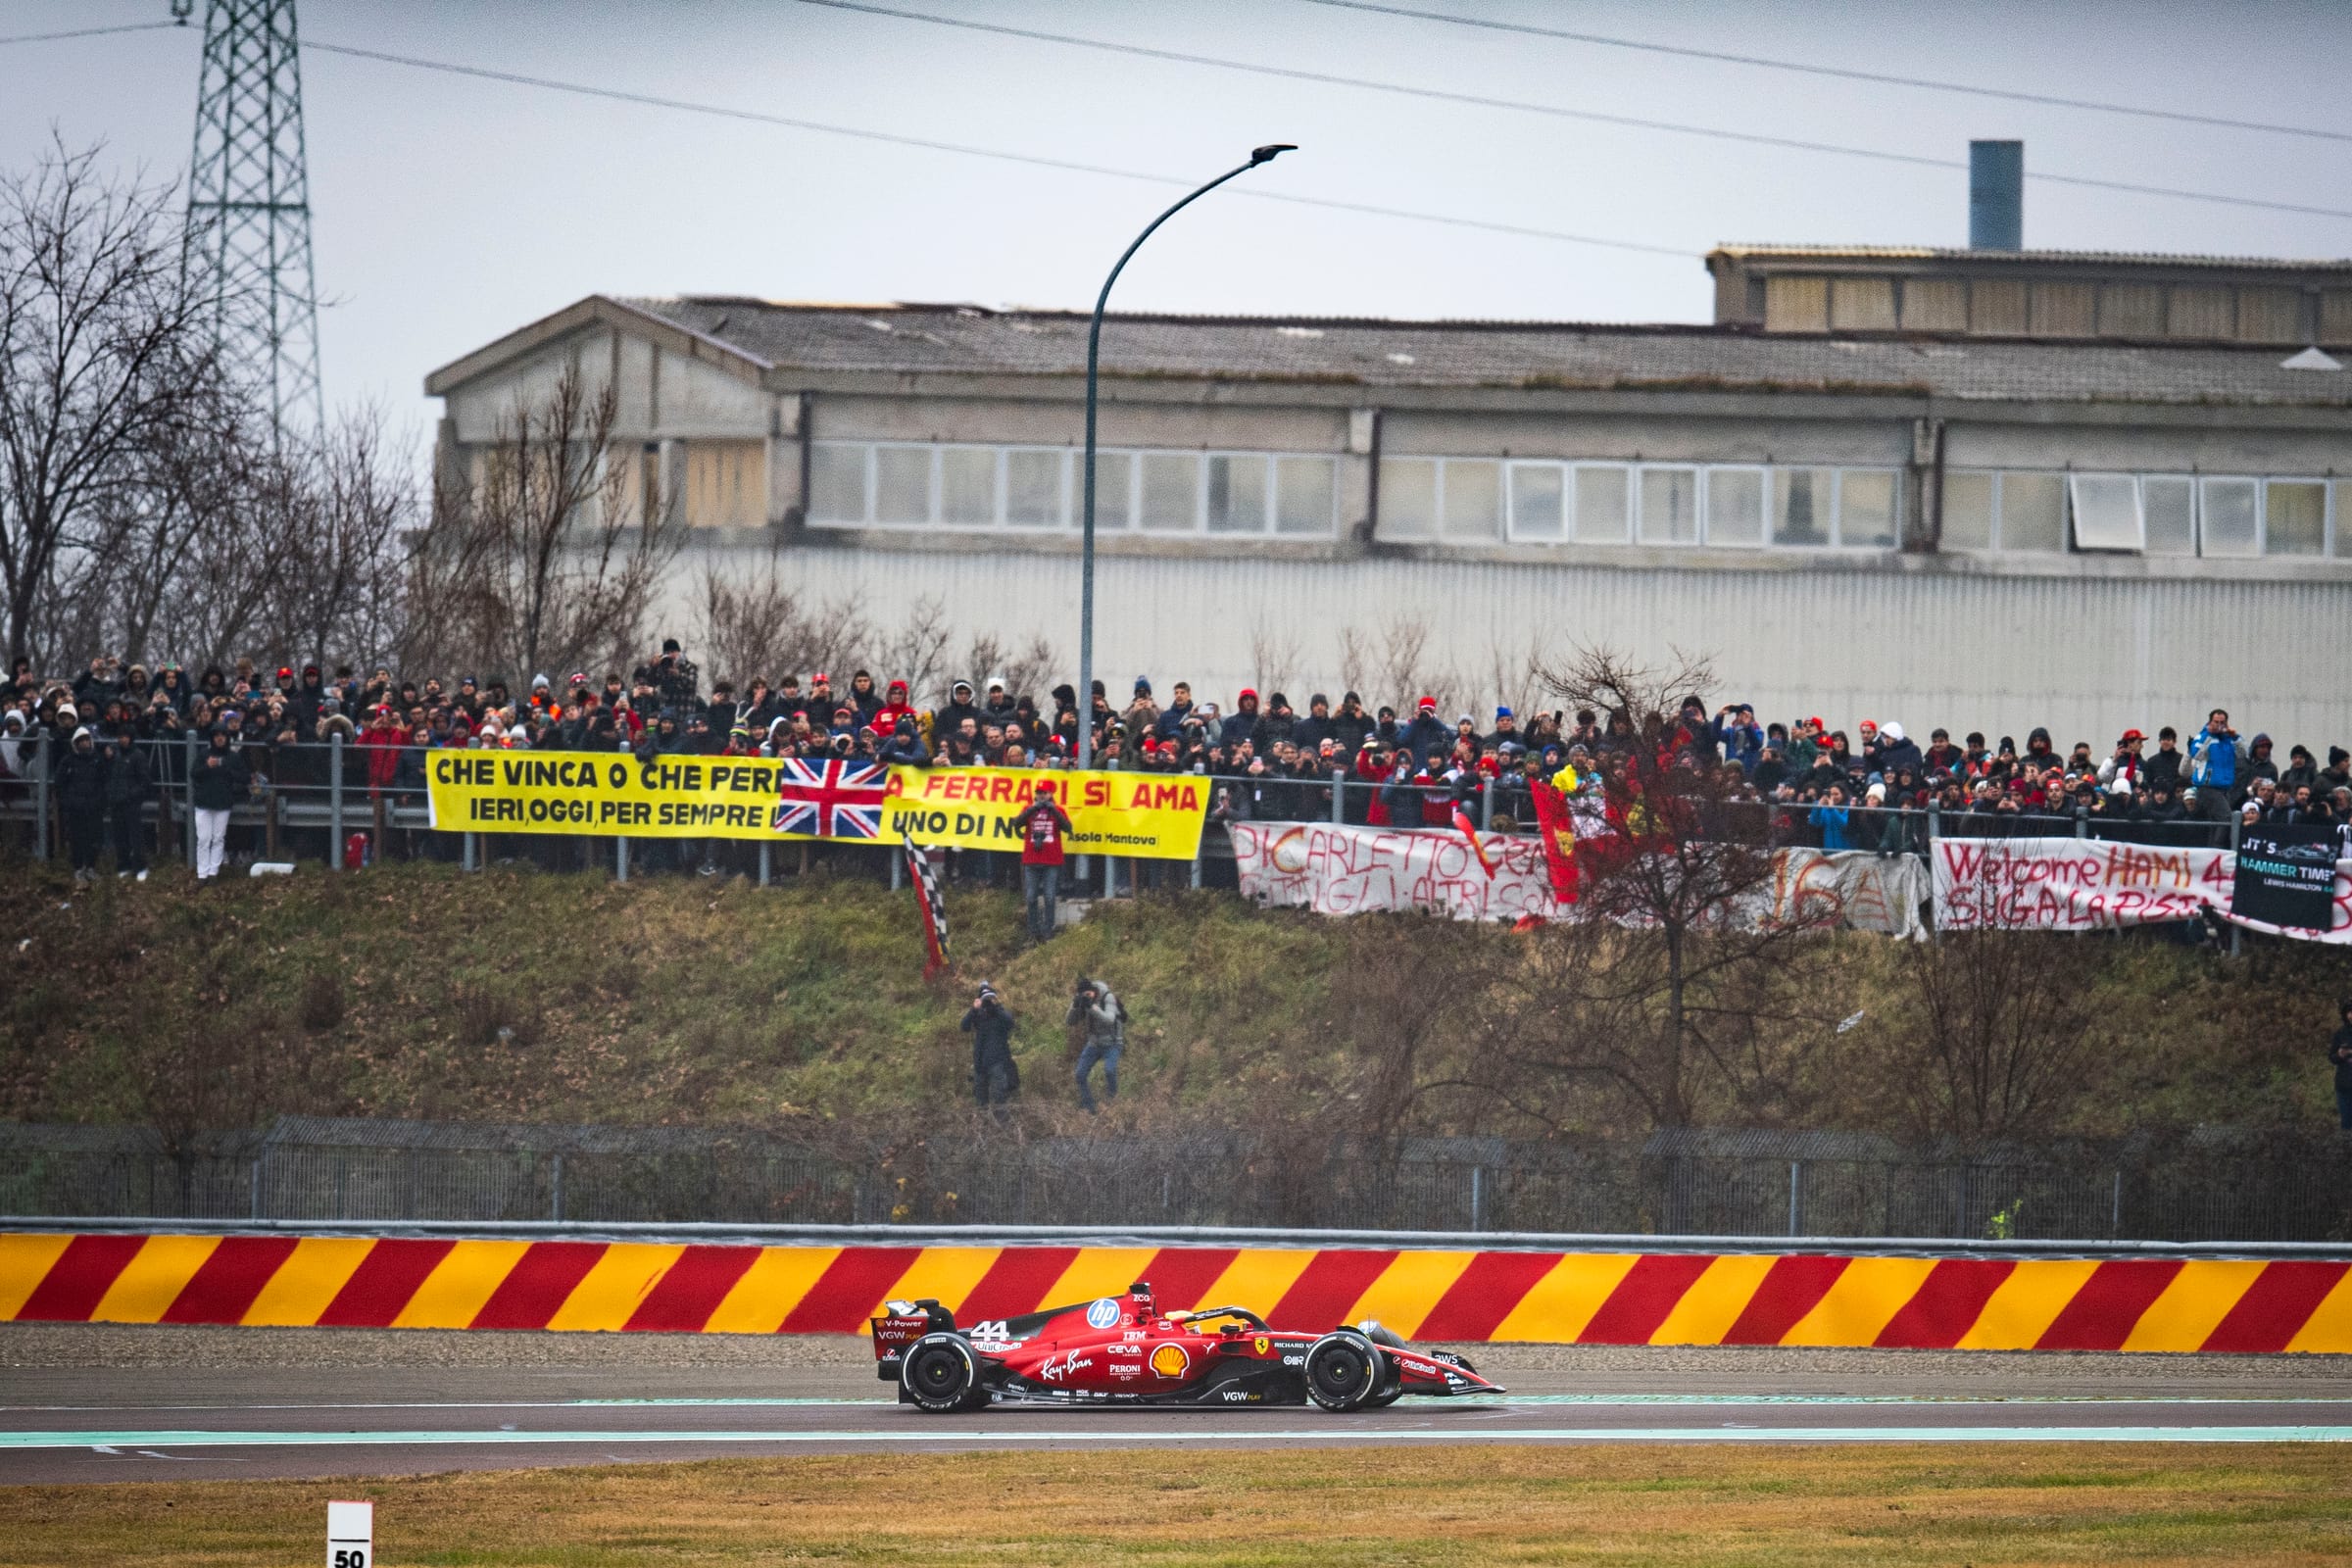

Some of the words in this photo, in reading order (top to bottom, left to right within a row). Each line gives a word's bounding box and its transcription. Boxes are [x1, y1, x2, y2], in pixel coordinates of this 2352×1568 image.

[436, 759, 495, 785] CHE
[504, 760, 598, 788] VINCA
[609, 762, 628, 789] O
[640, 764, 703, 791] CHE
[923, 775, 1068, 807] FERRAI
[658, 803, 763, 828] SEMPRE
[892, 810, 948, 835] UNO
[956, 813, 985, 837] DI
[1067, 832, 1102, 843] Asola
[1943, 843, 2101, 887] Welcome
[2201, 855, 2235, 893] 4
[2240, 857, 2297, 878] HAMMER
[2263, 877, 2285, 888] LEWIS
[2285, 881, 2323, 893] HAMILTON
[1091, 1299, 1117, 1327] hp
[878, 1331, 906, 1340] VGW
[970, 1320, 1010, 1342] 44
[1122, 1331, 1147, 1342] IBM
[1109, 1364, 1141, 1373] PERONI
[1223, 1392, 1248, 1401] VGW
[334, 1550, 365, 1568] 50
